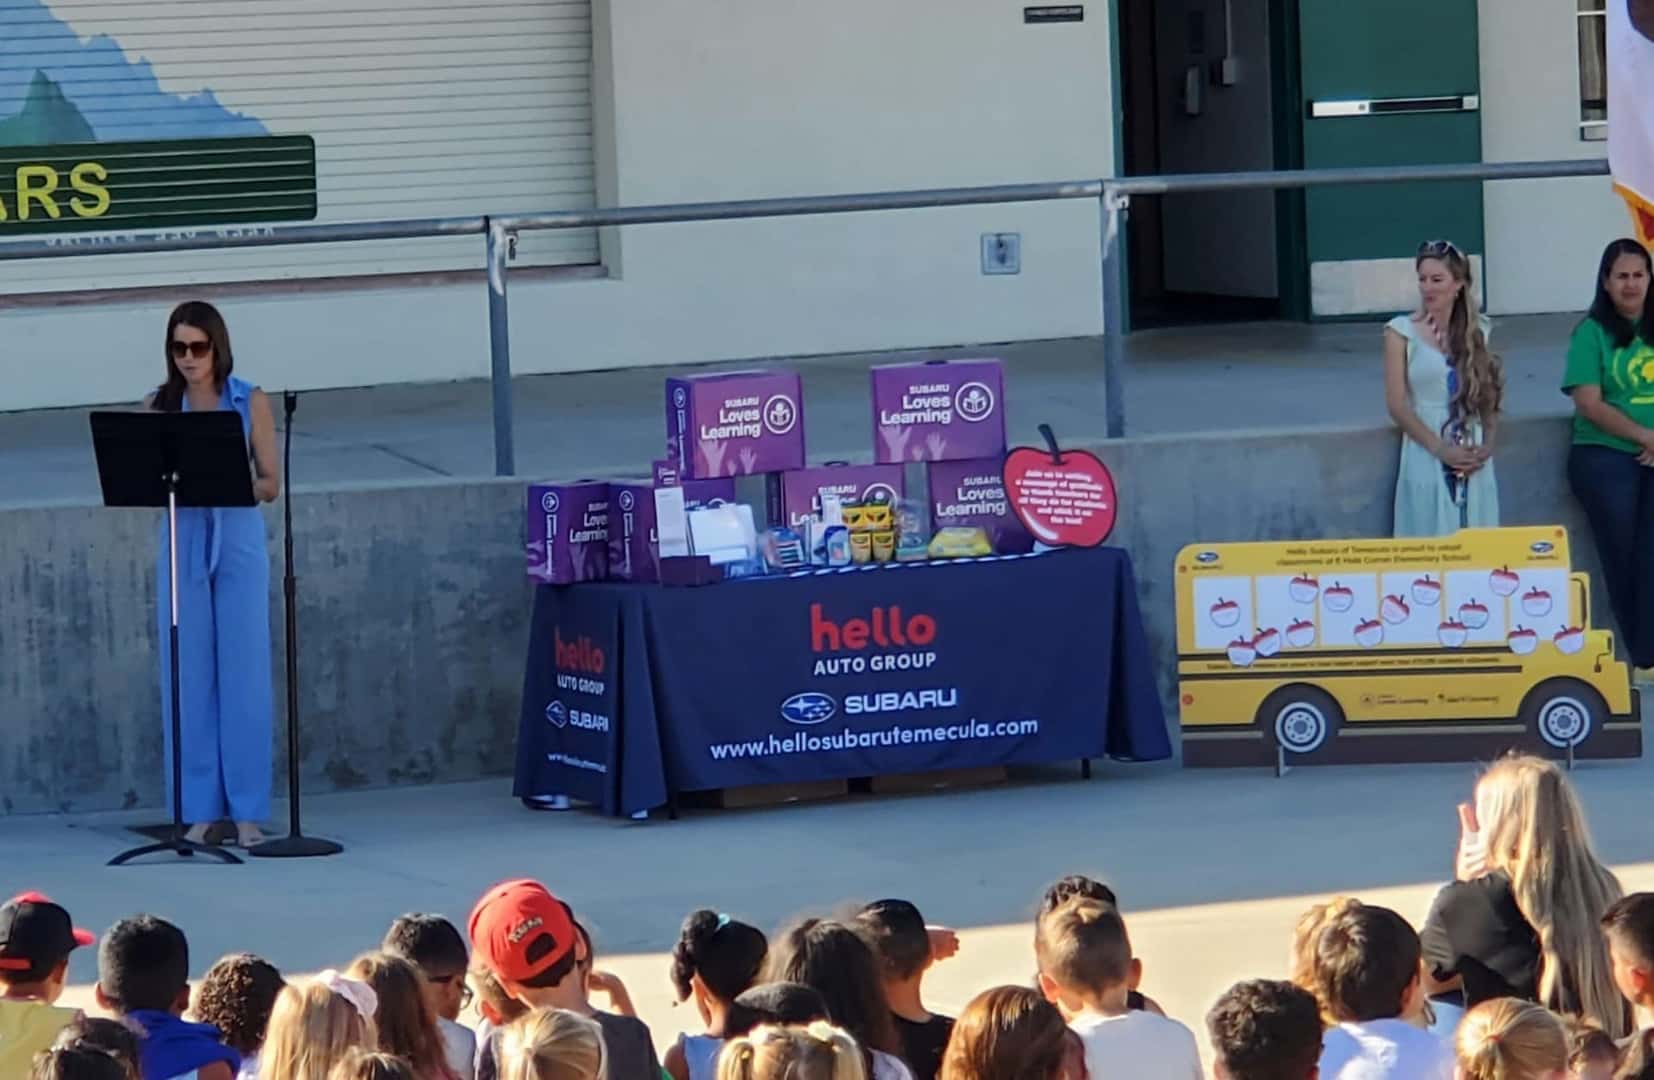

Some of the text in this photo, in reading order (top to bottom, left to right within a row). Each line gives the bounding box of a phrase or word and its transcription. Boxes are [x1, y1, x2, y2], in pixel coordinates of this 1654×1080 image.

[0, 162, 111, 221] RS
[909, 384, 949, 394] SUBARU
[725, 397, 759, 408] SUBARU
[902, 395, 951, 409] Loves
[720, 408, 760, 424] Loves
[881, 408, 951, 424] Learning
[701, 422, 760, 440] Learning
[957, 487, 1005, 501] Loves
[936, 501, 1007, 517] Learning
[584, 512, 608, 527] Love
[811, 603, 937, 652] hello
[555, 626, 605, 673] hello
[813, 652, 936, 676] AUTO GROUP
[579, 678, 605, 695] GROUP
[845, 688, 957, 714] SUBARU
[710, 718, 1039, 760] www.hellosubarutemecula.com
